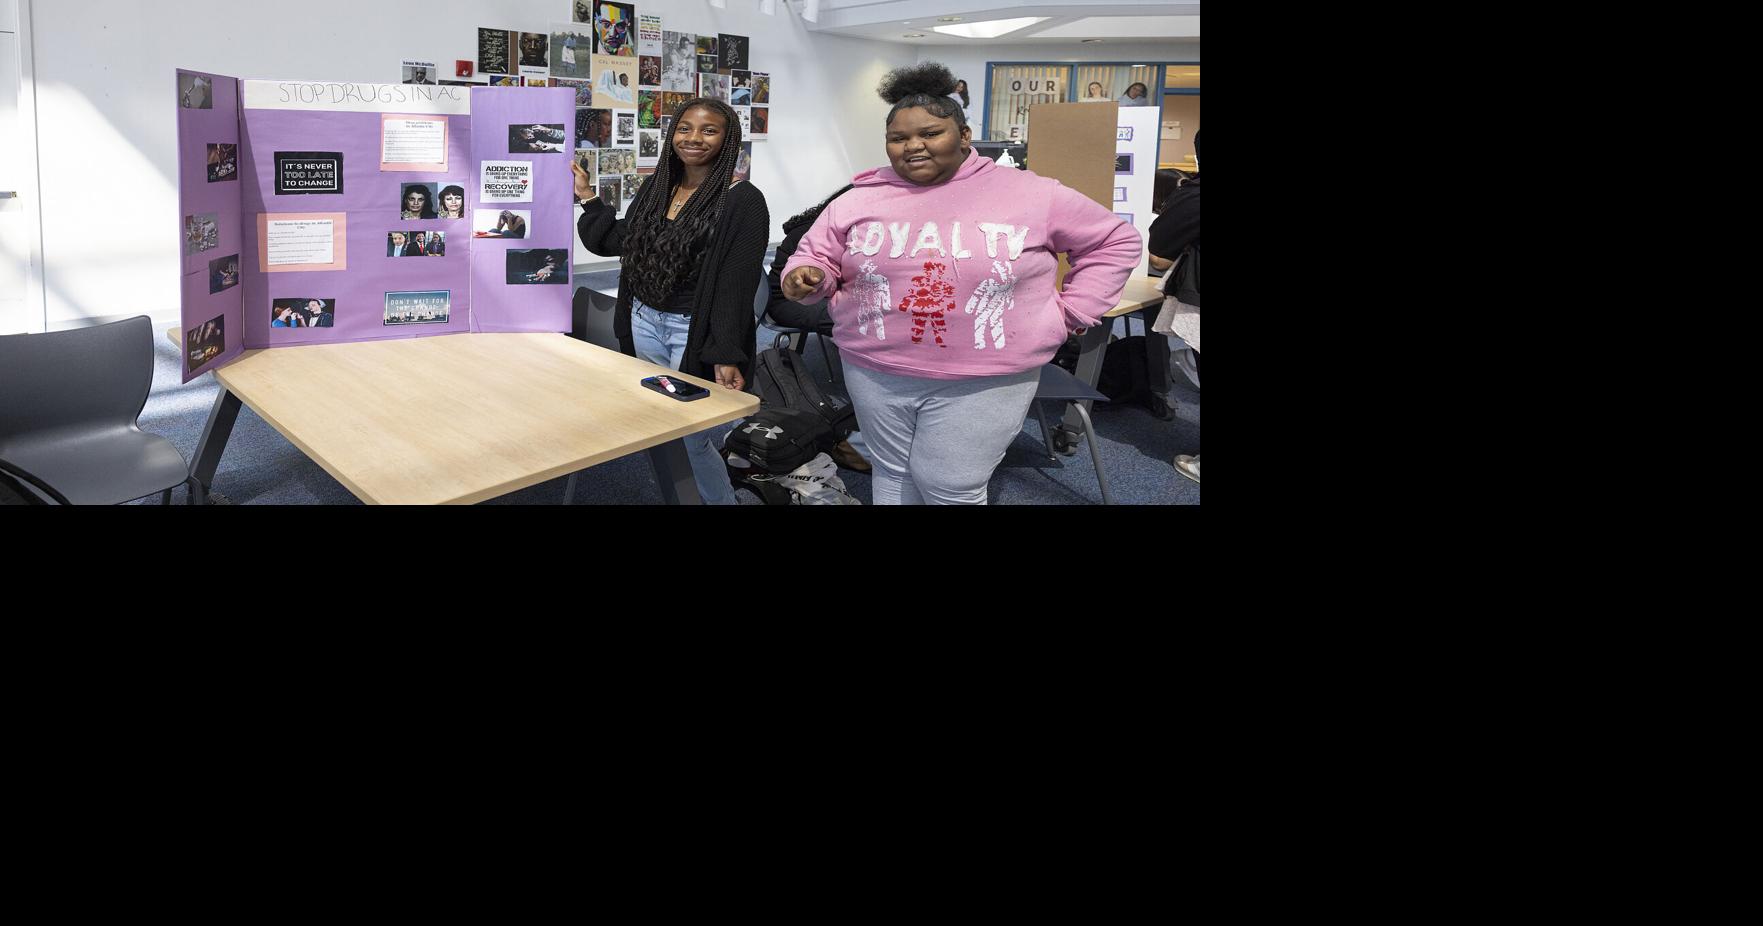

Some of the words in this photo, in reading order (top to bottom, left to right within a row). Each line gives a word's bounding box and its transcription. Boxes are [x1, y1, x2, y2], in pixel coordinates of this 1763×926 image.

[279, 83, 325, 103] STOP
[325, 83, 406, 103] DRUGS
[410, 86, 432, 101] IN
[437, 86, 461, 101] AC
[1011, 80, 1056, 92] OUR
[284, 171, 306, 179] TOO
[307, 171, 334, 179] LATE
[845, 221, 1030, 261] LOYALTY
